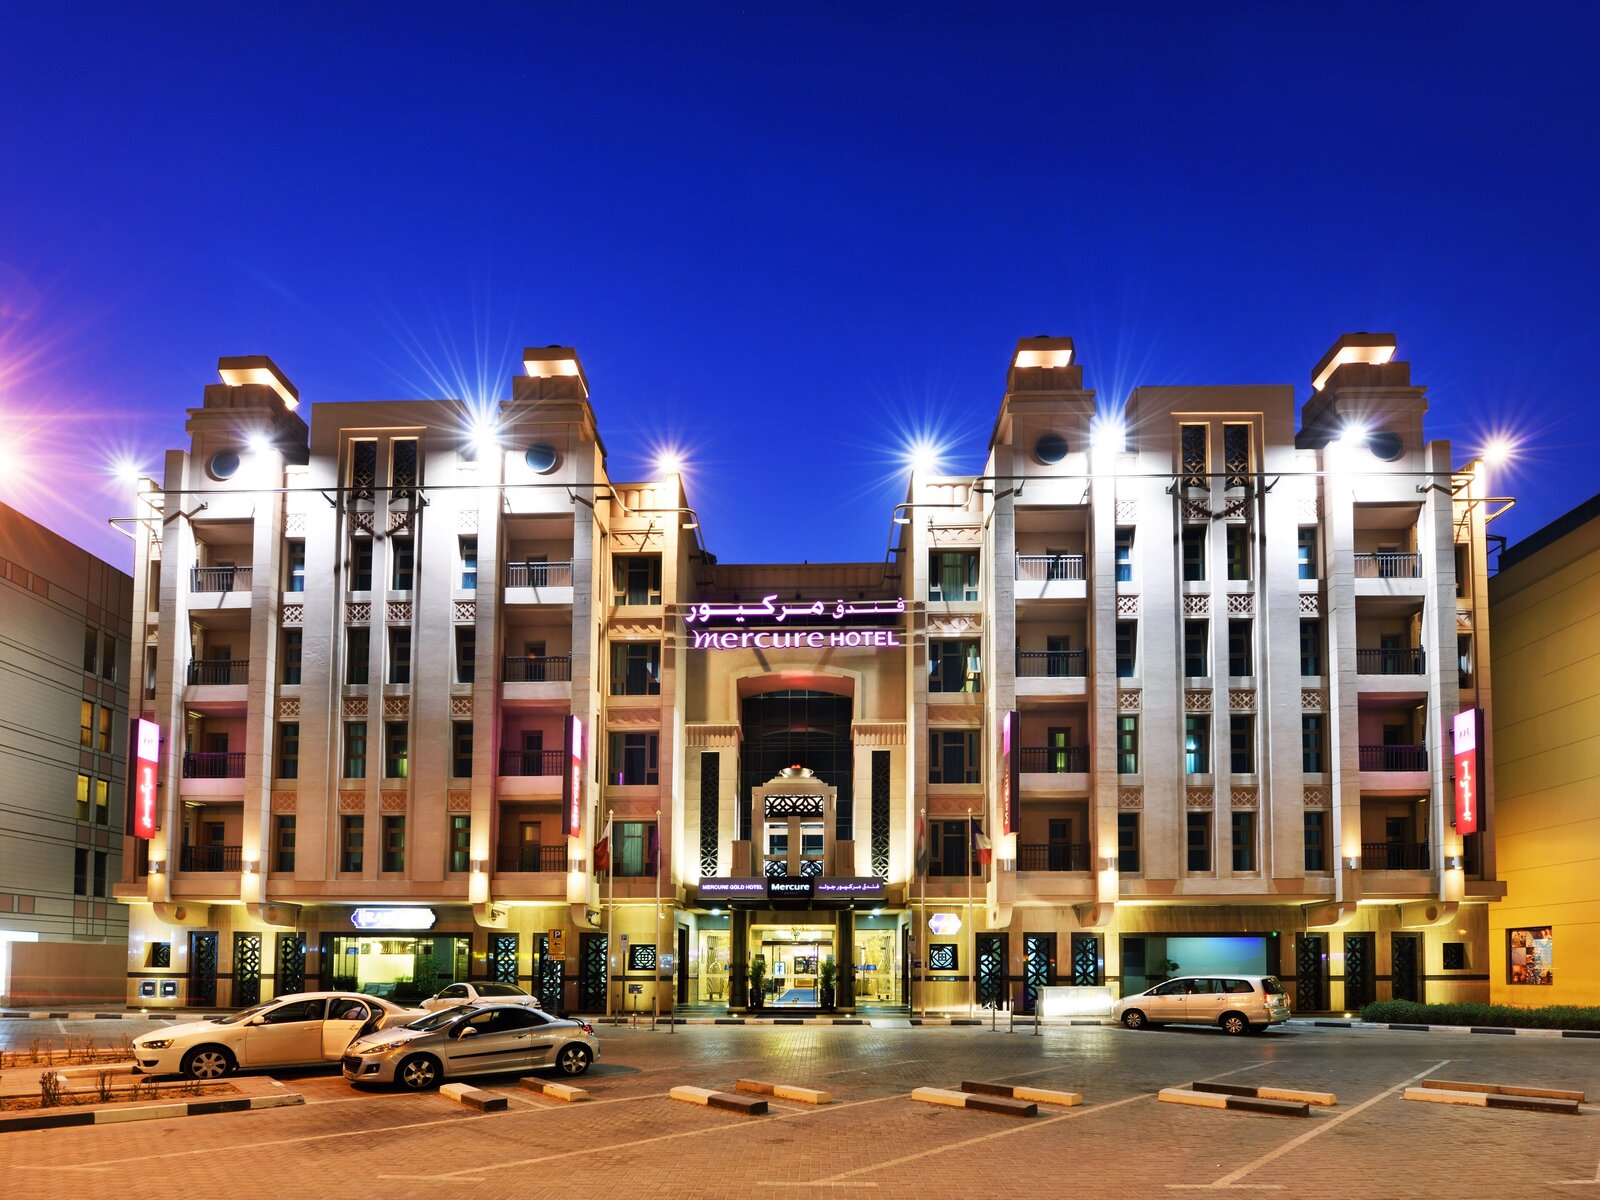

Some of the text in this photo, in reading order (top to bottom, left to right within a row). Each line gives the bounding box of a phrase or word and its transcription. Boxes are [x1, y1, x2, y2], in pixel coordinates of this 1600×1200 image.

[685, 594, 905, 622] فندق مركيور
[830, 631, 900, 646] HOTEL
[771, 883, 810, 891] Mercure
